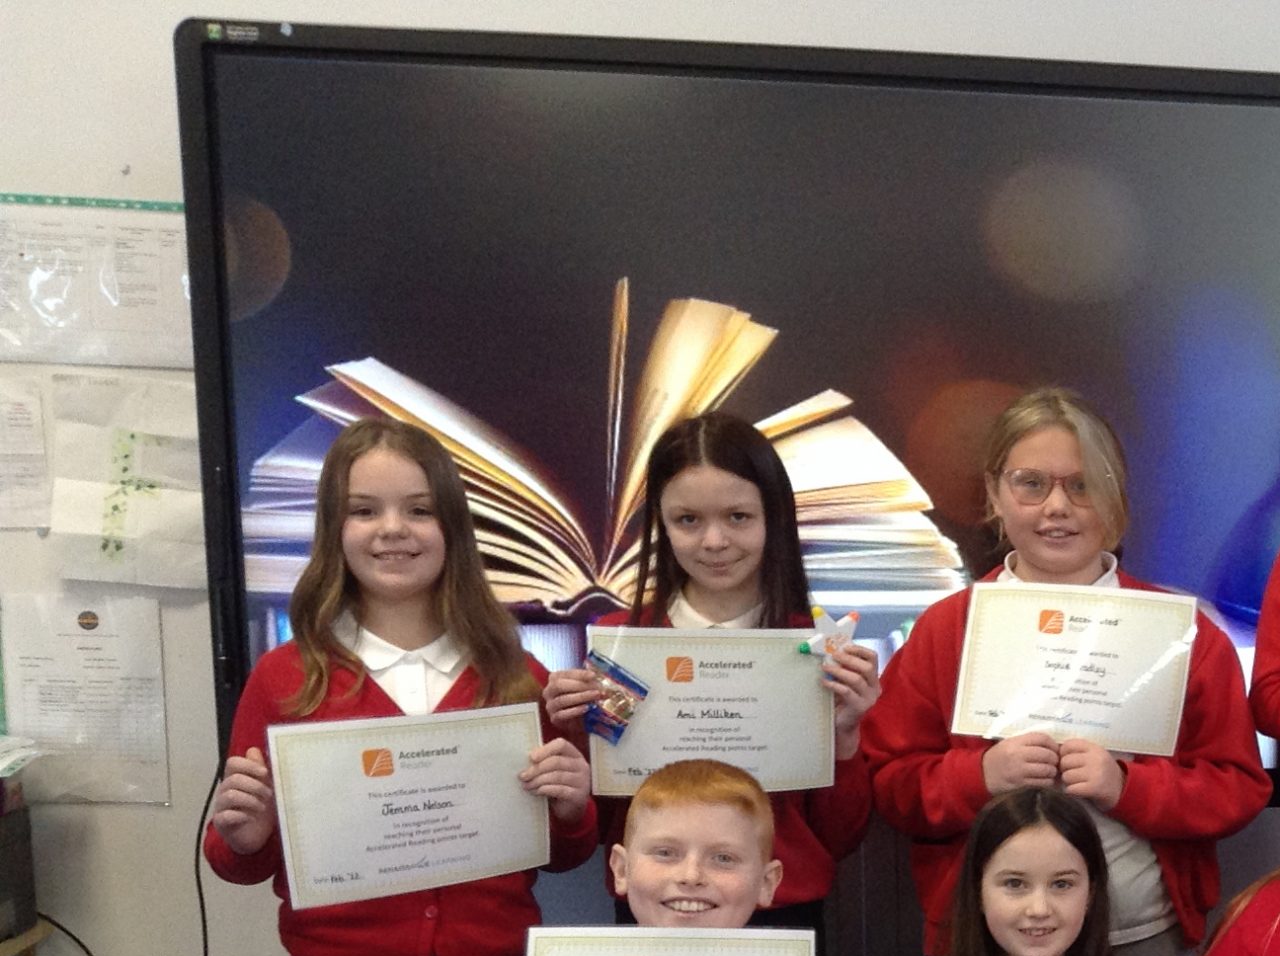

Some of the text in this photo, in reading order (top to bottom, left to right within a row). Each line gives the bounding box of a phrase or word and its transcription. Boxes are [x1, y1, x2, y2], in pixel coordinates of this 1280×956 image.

[699, 660, 753, 670] Accelerated
[398, 745, 458, 760] Accelerated
[383, 787, 418, 799] certificate
[428, 783, 458, 794] awarded
[381, 802, 420, 817] Jemma
